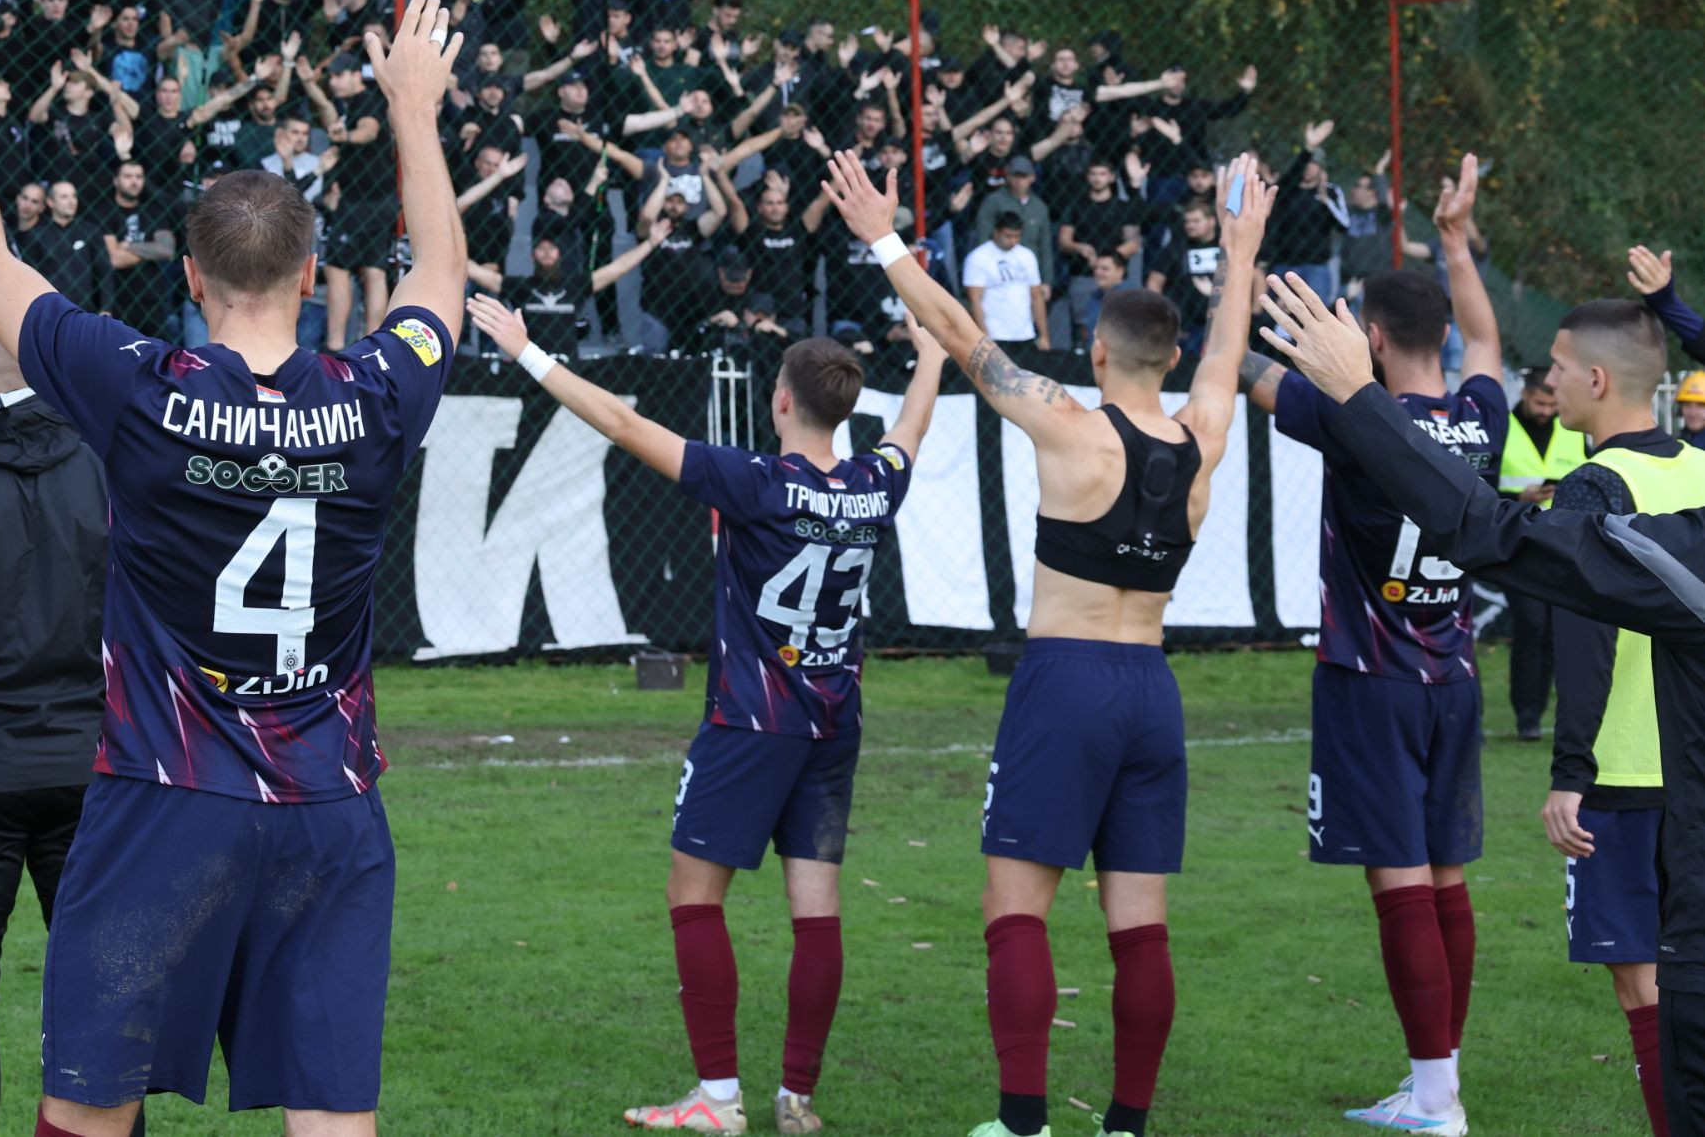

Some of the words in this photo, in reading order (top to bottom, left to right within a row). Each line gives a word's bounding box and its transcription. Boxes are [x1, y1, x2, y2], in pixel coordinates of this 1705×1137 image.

[162, 391, 366, 448] САНИЧАНИН
[185, 454, 348, 493] SOCCER
[785, 482, 890, 519] ТРИФУНОВИЋ
[794, 517, 878, 544] SOCCER
[213, 497, 318, 675] 4
[756, 542, 875, 650] 43
